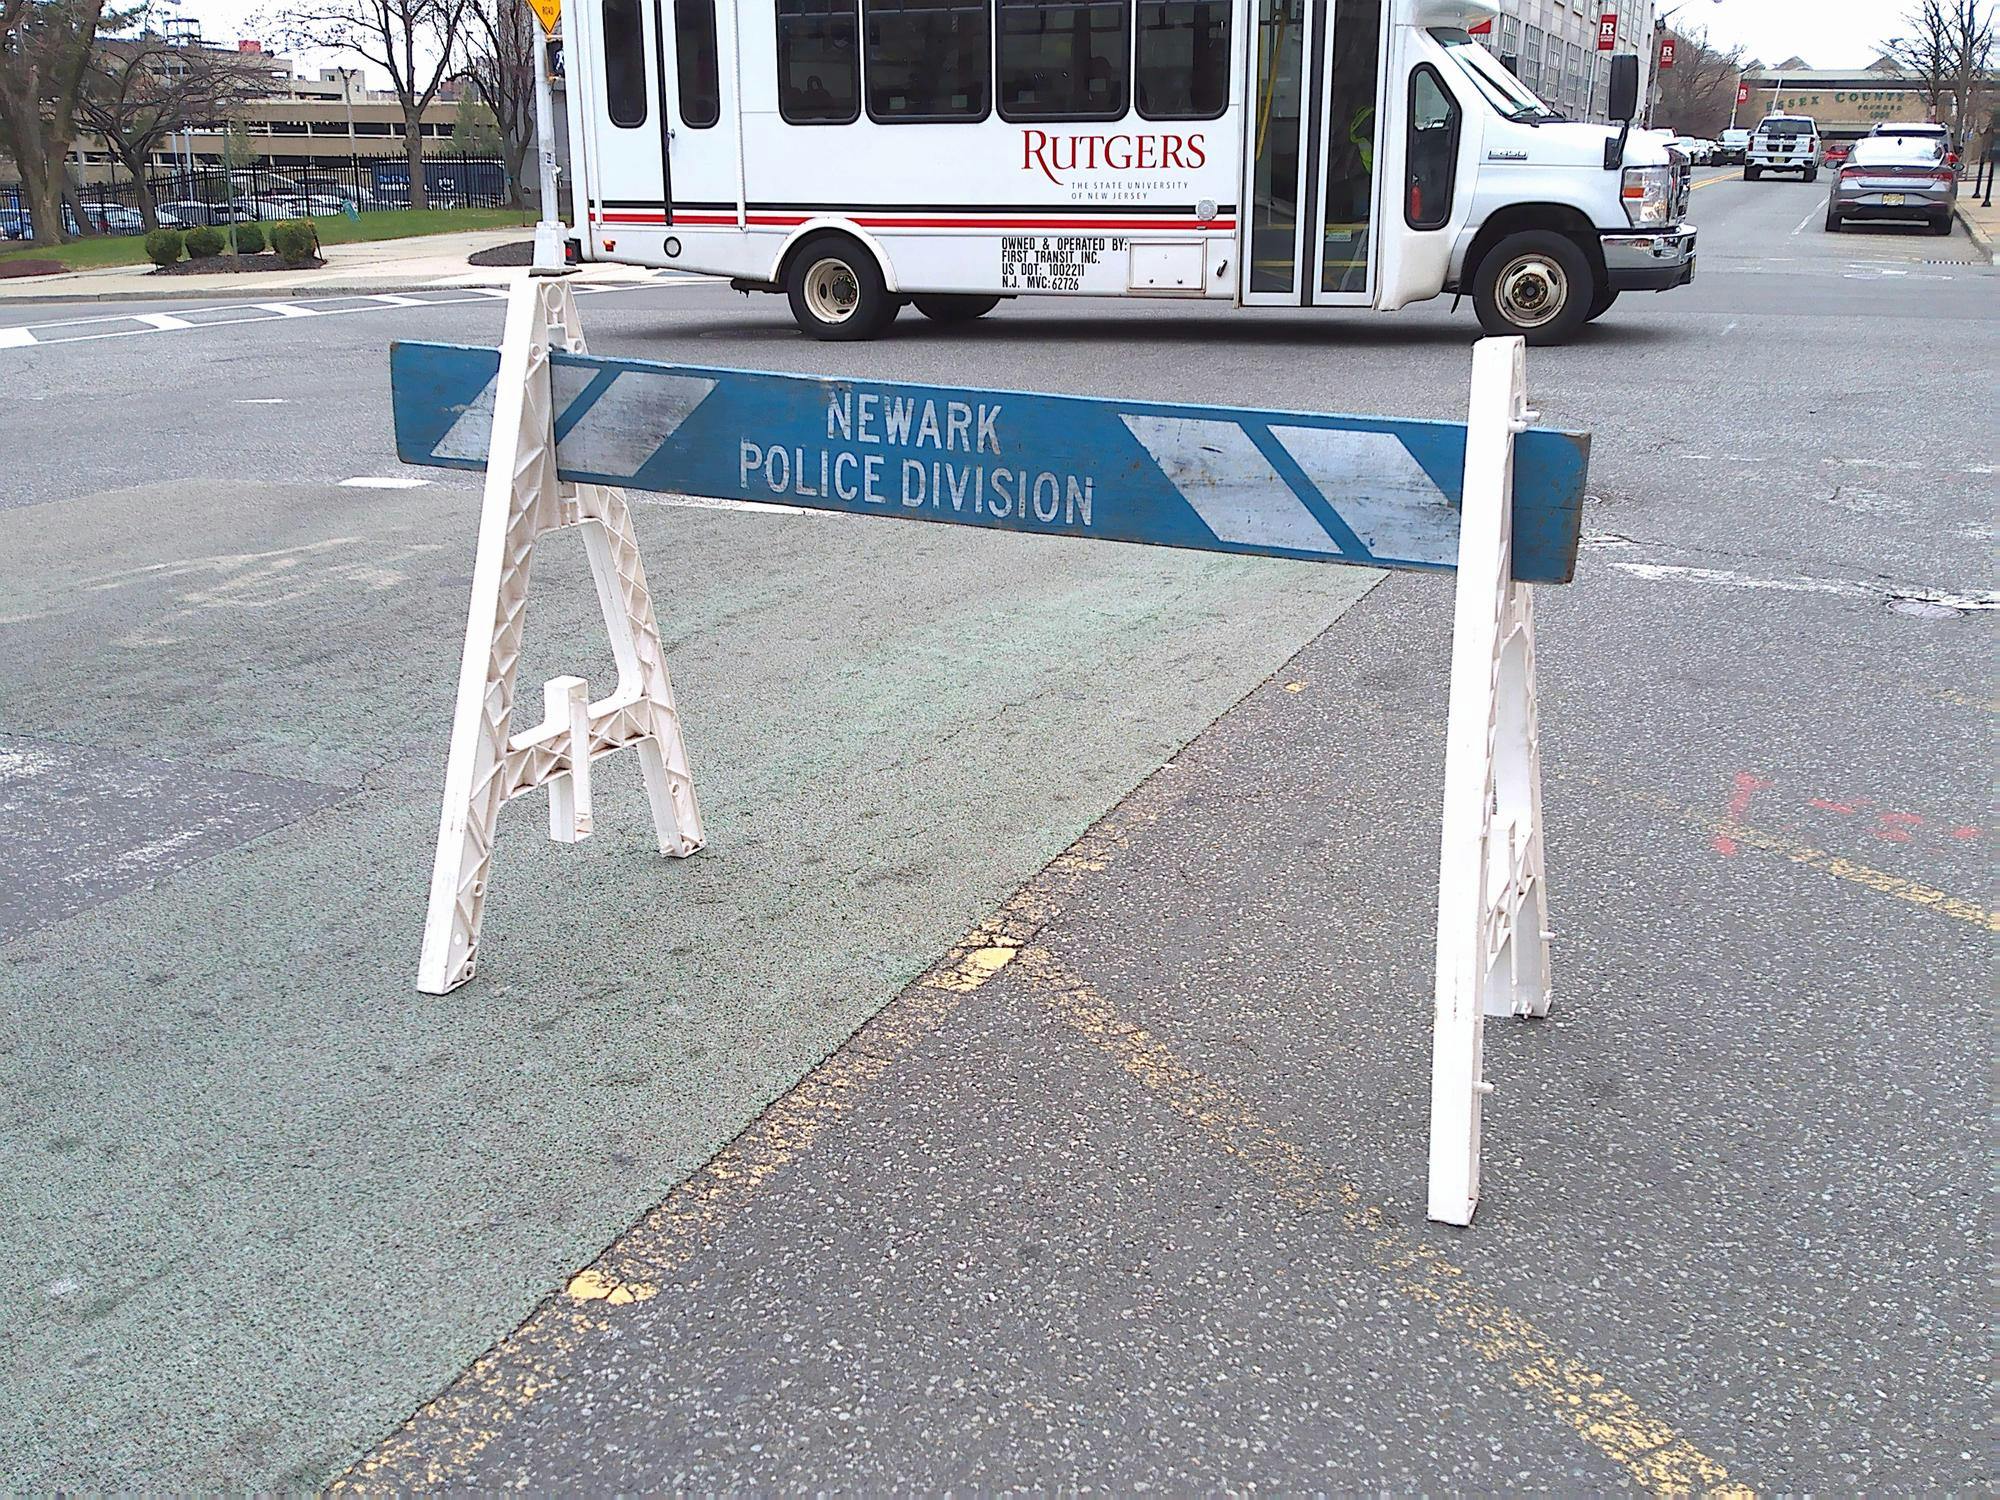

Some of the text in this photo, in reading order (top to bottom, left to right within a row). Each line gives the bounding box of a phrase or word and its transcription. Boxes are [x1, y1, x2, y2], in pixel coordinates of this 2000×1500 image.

[1601, 22, 1614, 35] R
[1662, 46, 1673, 56] R
[1766, 95, 1820, 112] ESSEX
[1834, 91, 1906, 104] COUNTY
[1021, 130, 1206, 186] RUTGERS
[1071, 181, 1189, 190] THE STATE UNIVERSITY
[1071, 192, 1148, 200] OF NEW JERSEY
[1001, 237, 1128, 251] OWNED & OPERATED BY:
[1001, 250, 1101, 264] FIRST TRANSIT INC.
[1002, 263, 1085, 276] US DOT: 1002211
[1002, 276, 1020, 288] N.J.
[826, 391, 1002, 455] NEWARK
[739, 437, 1093, 526] POLICE DIVISION
